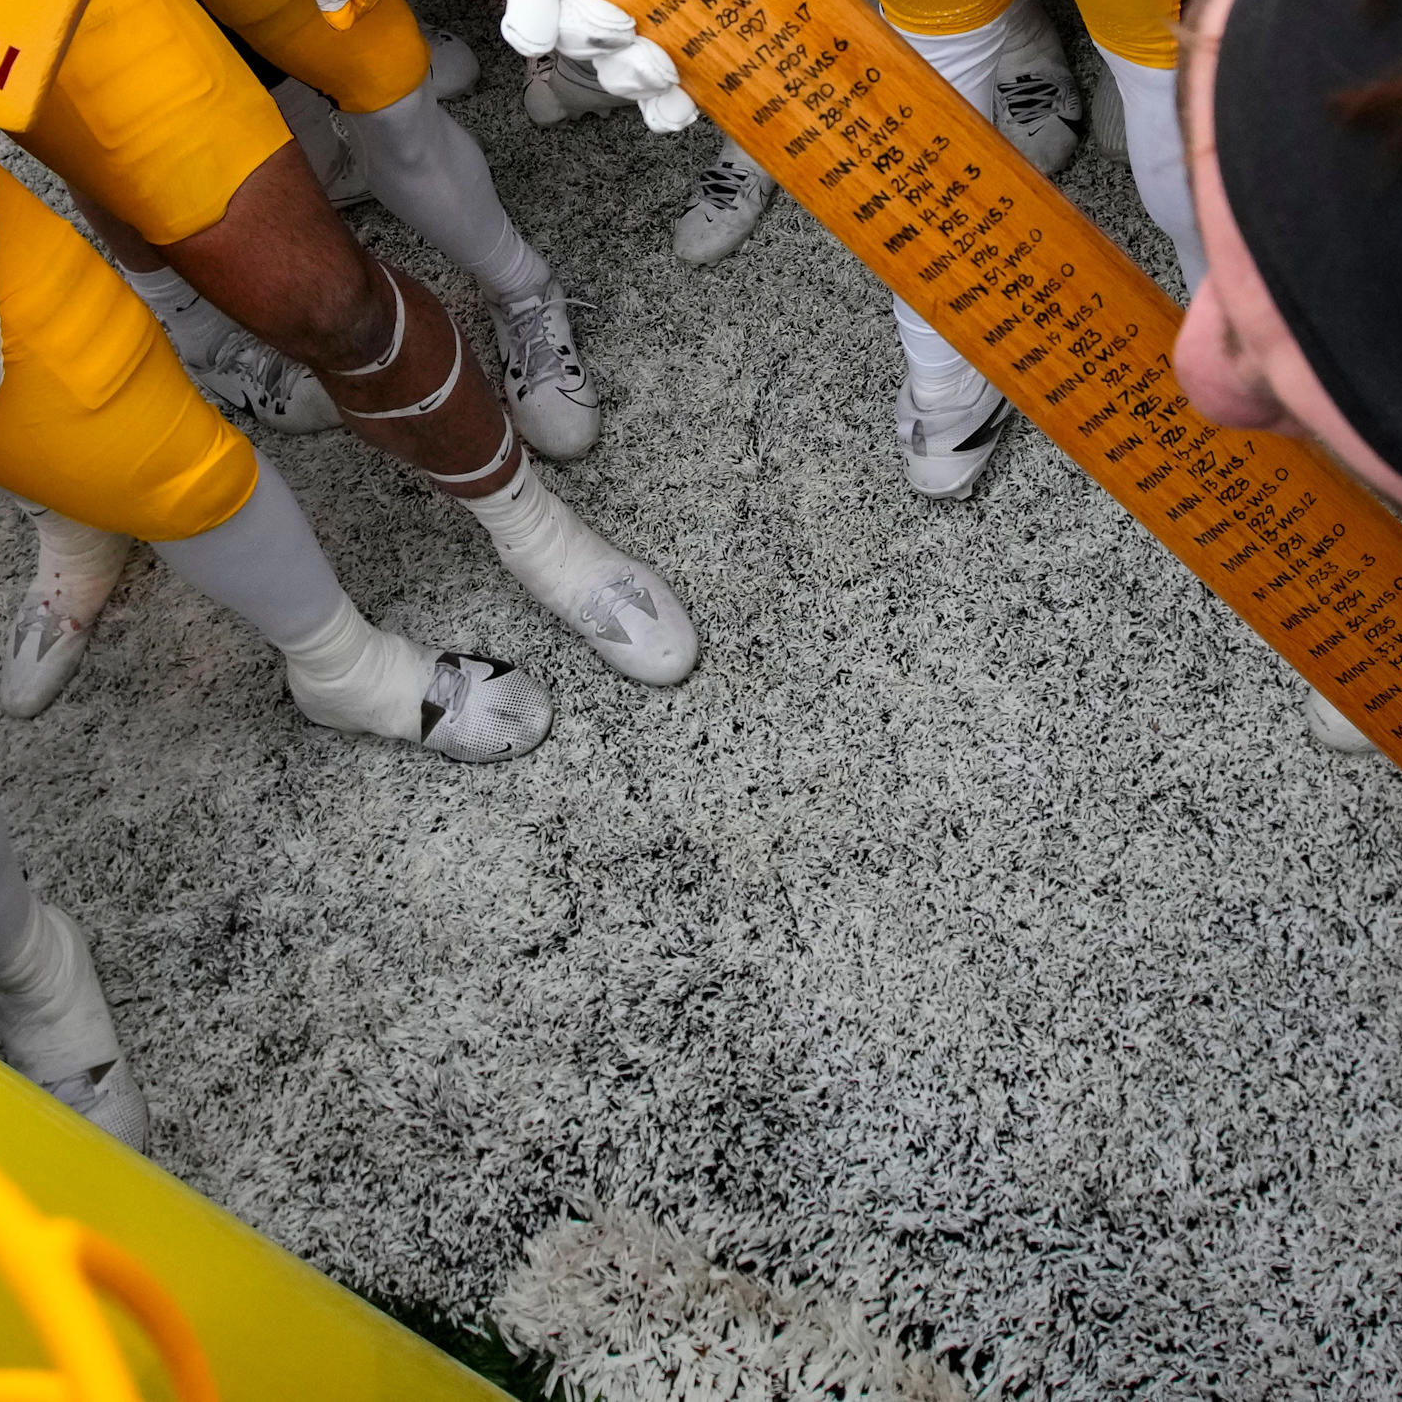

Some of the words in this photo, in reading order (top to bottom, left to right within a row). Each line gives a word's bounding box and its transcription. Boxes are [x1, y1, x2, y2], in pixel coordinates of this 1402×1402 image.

[736, 8, 769, 43] 1907
[680, 23, 719, 60] MINN.
[774, 42, 809, 78] 1909
[802, 81, 835, 112] 1910
[840, 114, 871, 144] 1911
[818, 153, 860, 190] MINN.
[871, 143, 905, 175] 1913
[903, 177, 935, 207] 1914
[937, 207, 969, 237] 1915
[969, 241, 999, 269] 1916
[1000, 271, 1035, 301] 1918
[1032, 300, 1064, 330] 1919
[1067, 327, 1103, 359] 1923
[1100, 360, 1133, 389] 1924
[1155, 423, 1188, 451] 1926
[1186, 450, 1218, 480] 1927
[1215, 476, 1251, 507] 1928
[1245, 503, 1278, 535] 1929
[1273, 531, 1307, 561] 1931
[1304, 559, 1339, 590] 1933
[1280, 599, 1321, 631] MINN.
[1332, 588, 1366, 616] 1934
[1362, 614, 1396, 644] 1935
